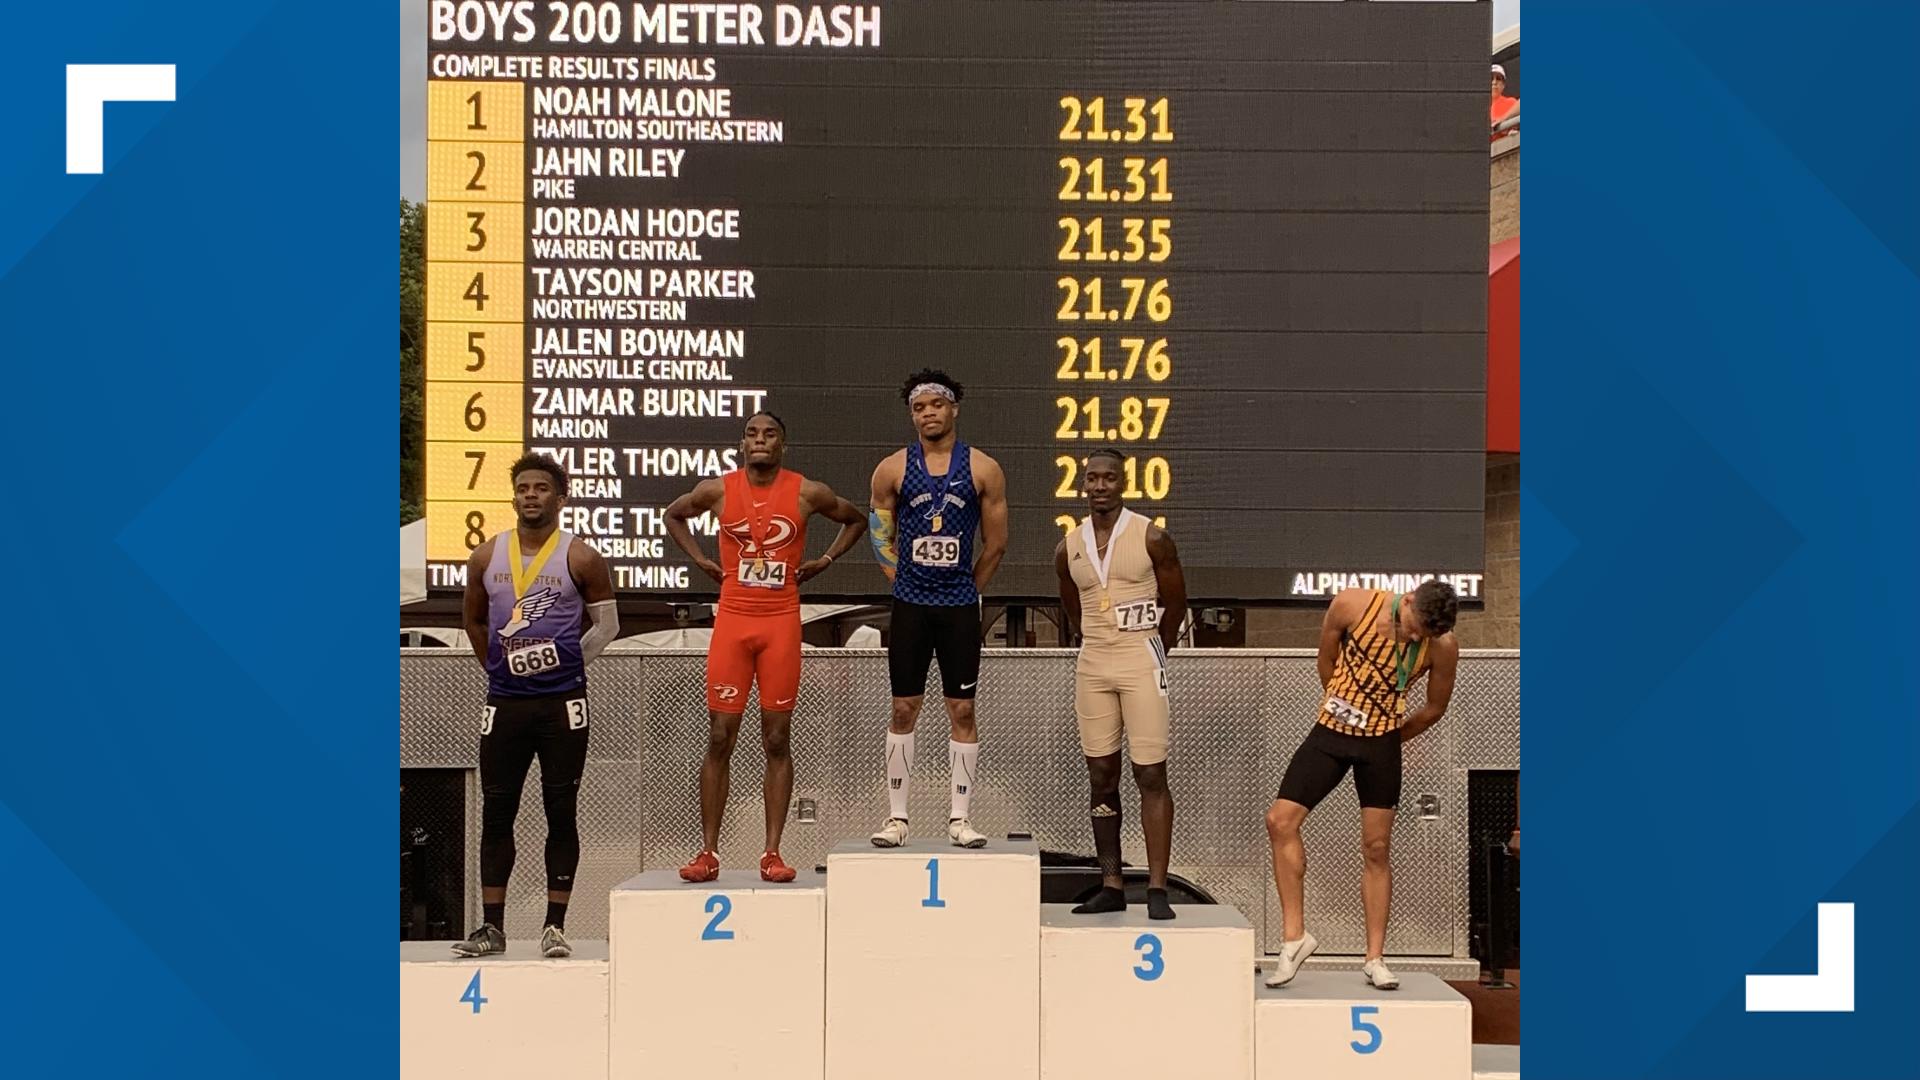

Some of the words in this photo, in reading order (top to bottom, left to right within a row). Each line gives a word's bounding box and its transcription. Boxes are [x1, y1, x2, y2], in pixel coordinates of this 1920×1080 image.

[431, 0, 535, 43] BOYS
[548, 1, 621, 44] 200
[633, 3, 764, 45] METER
[775, 4, 881, 47] DASH
[433, 54, 542, 78] COMPLETE
[548, 56, 639, 80] RESULTS
[645, 58, 716, 81] FINALS
[467, 91, 487, 131] 1
[534, 87, 611, 117] NOAH
[619, 88, 731, 118] MALONE
[533, 118, 632, 140] HAMILTON
[637, 120, 783, 142] SOUTHEASTERN
[1060, 97, 1174, 142] 21.31
[466, 151, 487, 191] 2
[532, 147, 602, 177] JAHN
[609, 149, 685, 178] RILEY
[533, 179, 575, 200] PIKE
[1059, 158, 1173, 202] 21.31
[466, 212, 487, 252] 3
[532, 208, 640, 237] JORDAN
[648, 209, 740, 239] HODGE
[532, 239, 613, 260] WARREN
[619, 240, 702, 261] CENTRAL
[1058, 218, 1172, 262] 21.35
[463, 272, 489, 311] 4
[532, 268, 643, 297] TAYSON
[650, 269, 755, 299] PARKER
[533, 299, 686, 321] NORTHWESTERN
[1057, 278, 1171, 322] 21.76
[465, 332, 486, 372] 5
[532, 328, 613, 356] JALEN
[621, 330, 744, 358] BOWMAN
[533, 359, 644, 380] EVANSVILLE
[648, 360, 732, 381] CENTRAL
[1057, 338, 1171, 382] 21.76
[464, 391, 487, 432] 6
[532, 388, 636, 416] ZAIMAR
[644, 388, 768, 418] BURNETT
[532, 418, 608, 439] MARION
[1056, 397, 1170, 441] 21.87
[465, 452, 486, 490] 7
[623, 448, 738, 477] THOMAS
[1055, 456, 1170, 500] 210
[567, 478, 622, 499] REAN
[464, 511, 486, 552] 8
[559, 507, 623, 535] ERCE
[915, 541, 958, 562] 439
[614, 566, 689, 589] TIMING
[742, 561, 784, 582] 704
[1118, 603, 1157, 626] 775
[511, 647, 557, 674] 668
[482, 707, 491, 733] 3
[572, 701, 584, 727] 3
[921, 858, 946, 908] 1
[701, 895, 735, 941] 2
[1133, 934, 1165, 982] 3
[459, 969, 488, 1014] 4
[1350, 1006, 1383, 1055] 5
